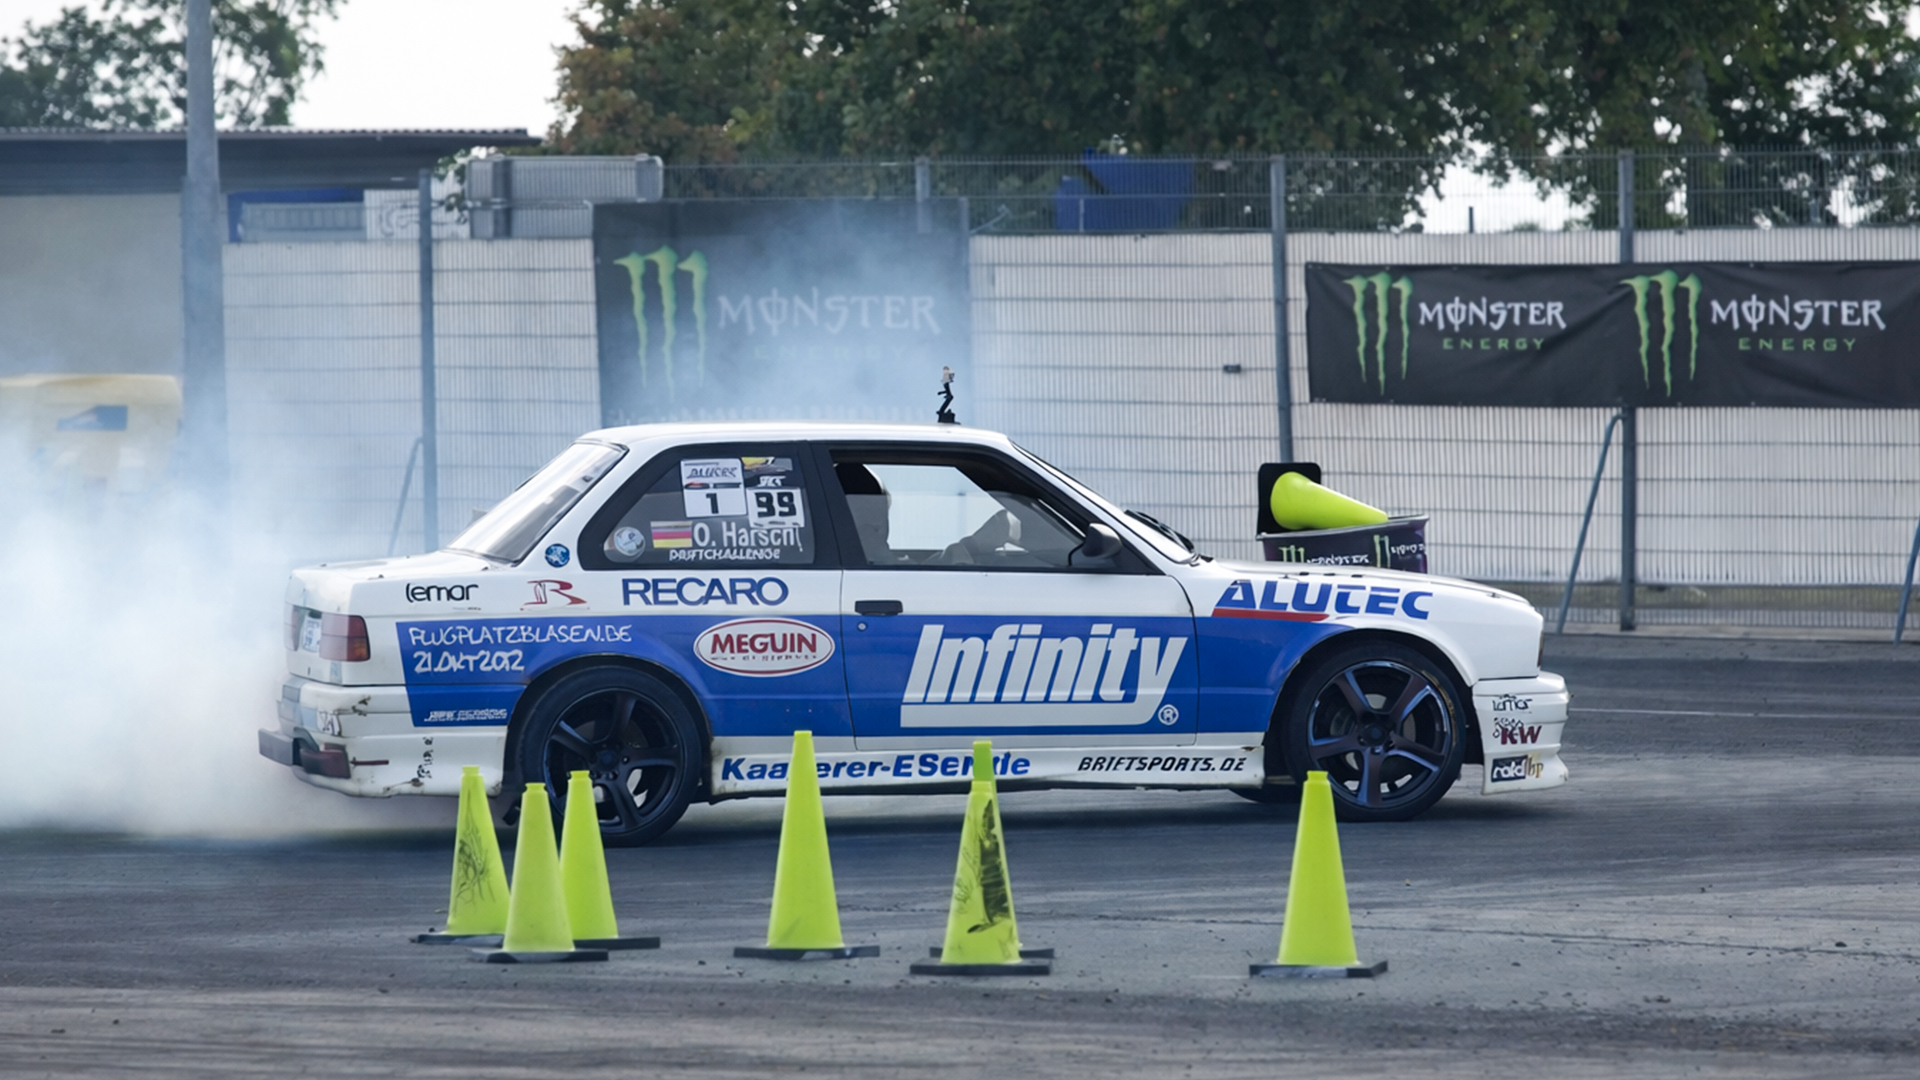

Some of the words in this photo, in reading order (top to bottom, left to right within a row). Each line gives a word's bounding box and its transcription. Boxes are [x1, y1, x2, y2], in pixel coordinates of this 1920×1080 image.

[717, 286, 942, 336] MONSTER
[1419, 296, 1567, 333] MONSTER
[1710, 294, 1886, 332] MONSTER
[1442, 338, 1545, 350] ENERGY
[1738, 337, 1856, 351] ENERGY
[706, 492, 719, 515] 1
[621, 577, 789, 606] RECARO
[1214, 579, 1433, 620] ALUTEC
[711, 633, 817, 654] MEGUIN
[900, 624, 1188, 727] Infinity
